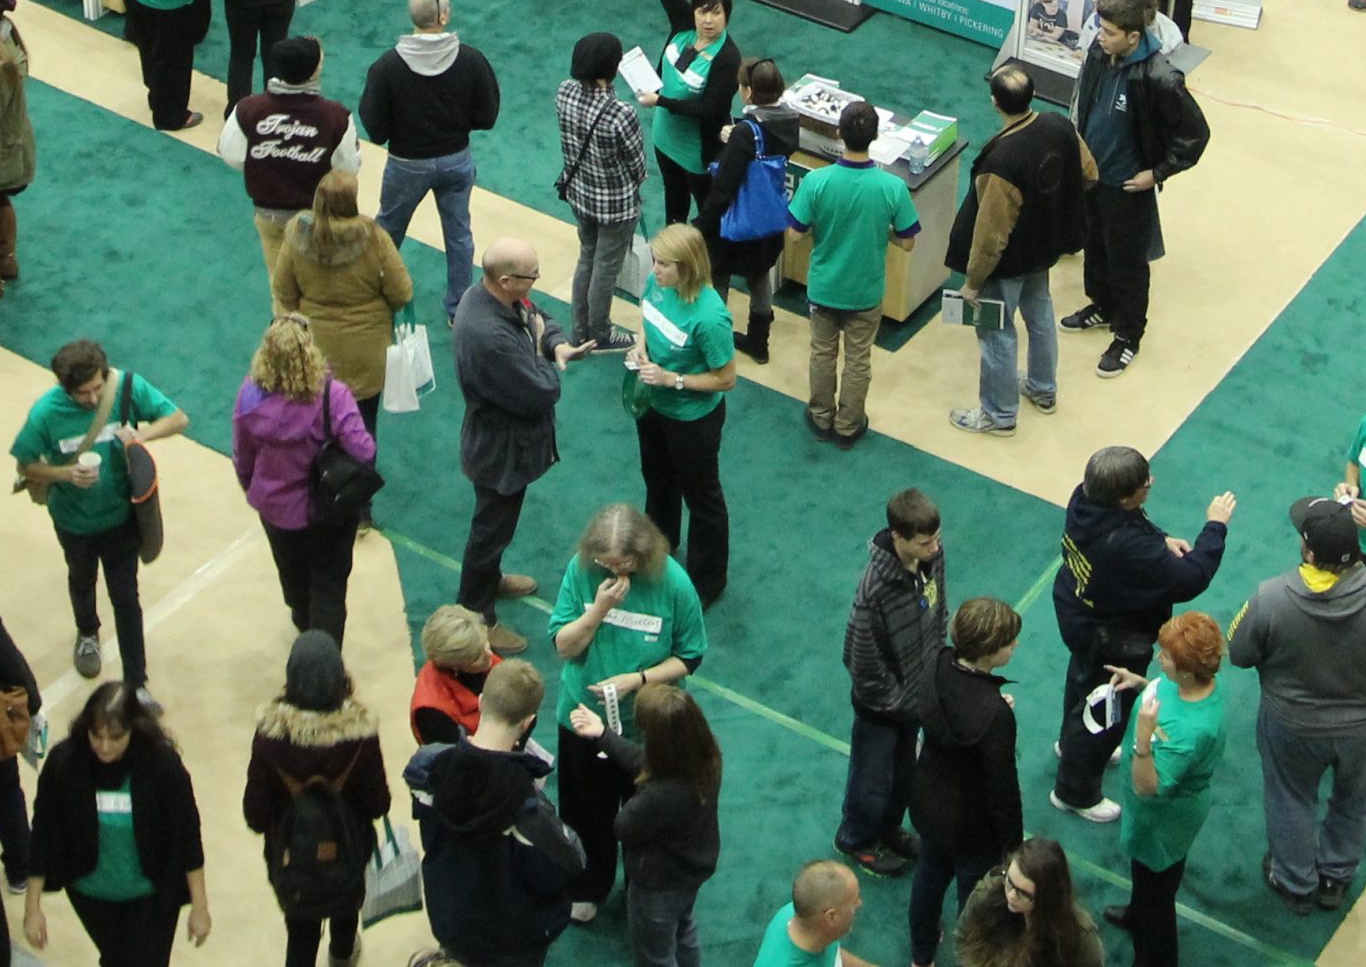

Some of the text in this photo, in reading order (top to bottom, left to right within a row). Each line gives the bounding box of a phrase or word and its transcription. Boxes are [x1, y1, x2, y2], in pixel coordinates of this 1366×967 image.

[919, 2, 952, 20] WHITBY
[959, 16, 1004, 39] PICKERING
[256, 114, 319, 141] Trojan
[250, 139, 327, 163] Football
